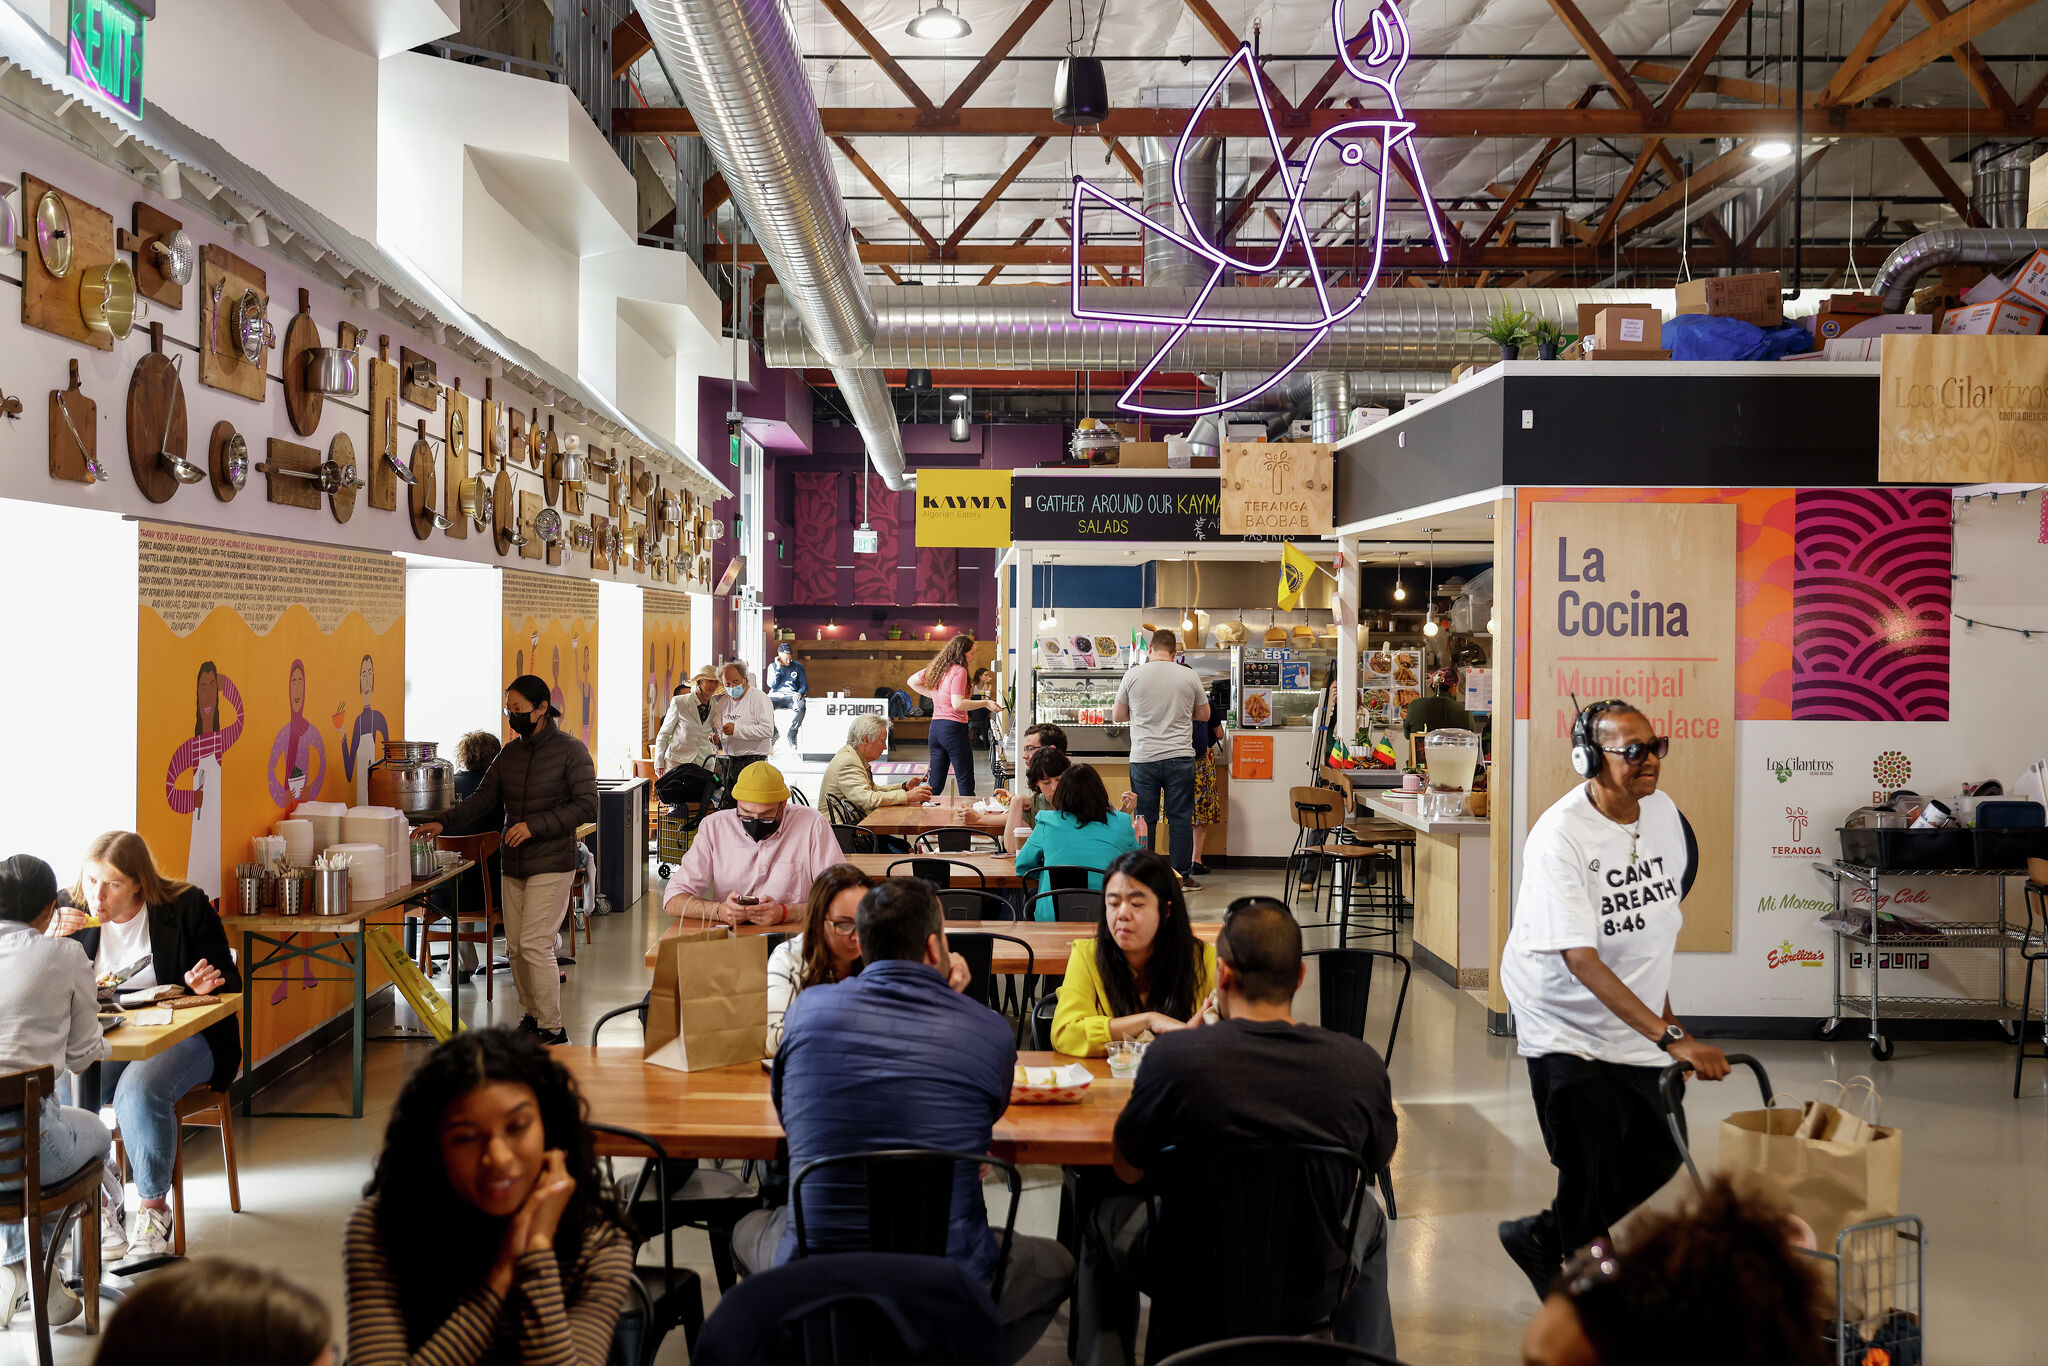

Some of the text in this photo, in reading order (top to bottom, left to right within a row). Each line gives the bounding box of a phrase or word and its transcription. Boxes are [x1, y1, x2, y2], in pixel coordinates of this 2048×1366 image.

[86, 0, 135, 104] EXIT
[1894, 376, 1934, 409] Los
[923, 496, 1007, 509] KAYMA
[1036, 494, 1085, 513] GATHER
[1091, 494, 1143, 514] AROUND
[1148, 494, 1173, 514] OUR
[1245, 501, 1309, 512] TERANGA
[922, 510, 982, 519] Algerian Eatery
[1246, 514, 1309, 528] BAOBAB
[1078, 519, 1129, 534] SALADS
[1558, 536, 1606, 583] La
[1557, 589, 1689, 637] Cocina
[1264, 650, 1290, 660] EBT
[1556, 668, 1684, 702] Municipal
[1556, 710, 1720, 739] Mplace
[1766, 756, 1834, 771] Los Cilantros
[1771, 846, 1822, 855] TERANGA
[1605, 856, 1664, 888] CAN'T
[1601, 877, 1677, 916] BREATH
[1757, 894, 1836, 913] Mi Morena
[1893, 887, 1932, 904] Cali
[1603, 912, 1646, 936] 8:46
[1767, 949, 1825, 969] Estrellita's
